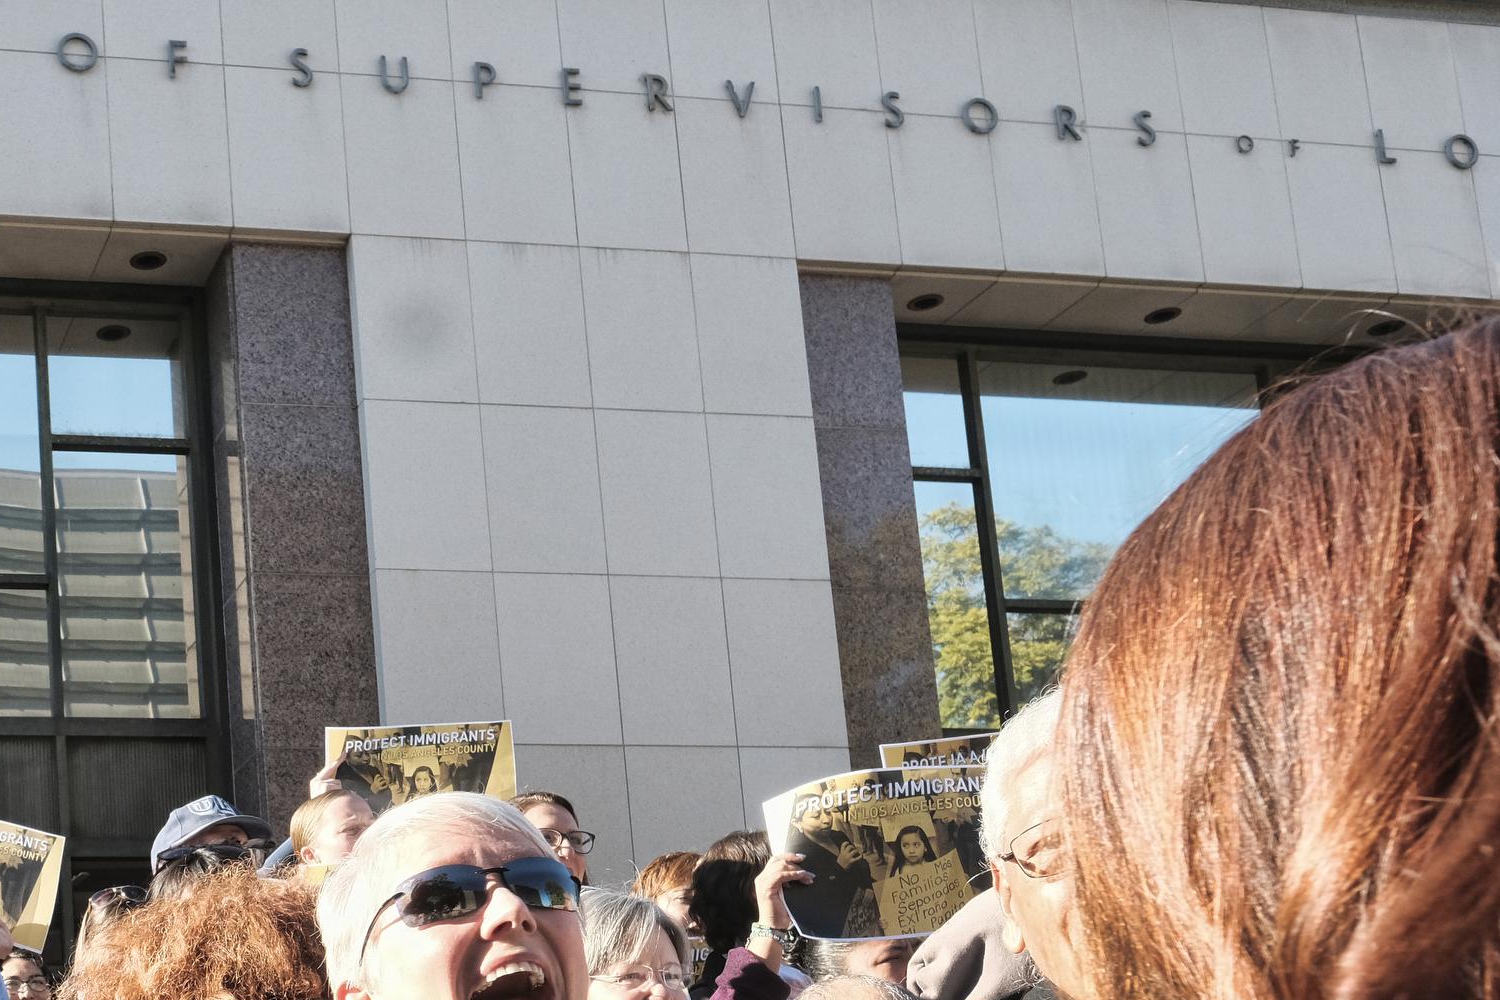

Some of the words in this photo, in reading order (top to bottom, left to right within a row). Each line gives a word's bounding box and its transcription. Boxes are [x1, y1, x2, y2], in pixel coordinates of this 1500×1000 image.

[57, 32, 188, 80] OF
[291, 47, 1158, 149] SUPERVISORS
[1235, 134, 1302, 158] OF
[1375, 128, 1479, 172] LO
[345, 735, 407, 753] PROTECT
[409, 728, 496, 746] IMMIGRANTS
[410, 748, 455, 759] ANGELES
[457, 743, 496, 754] COUNTY
[795, 783, 883, 818] PROTECT
[843, 809, 859, 823] IN
[861, 804, 888, 819] LOS
[891, 797, 953, 817] ANGELES
[11, 847, 47, 863] COUNTY
[891, 871, 948, 904] Familias
[899, 873, 920, 888] No
[898, 878, 960, 915] Separadas
